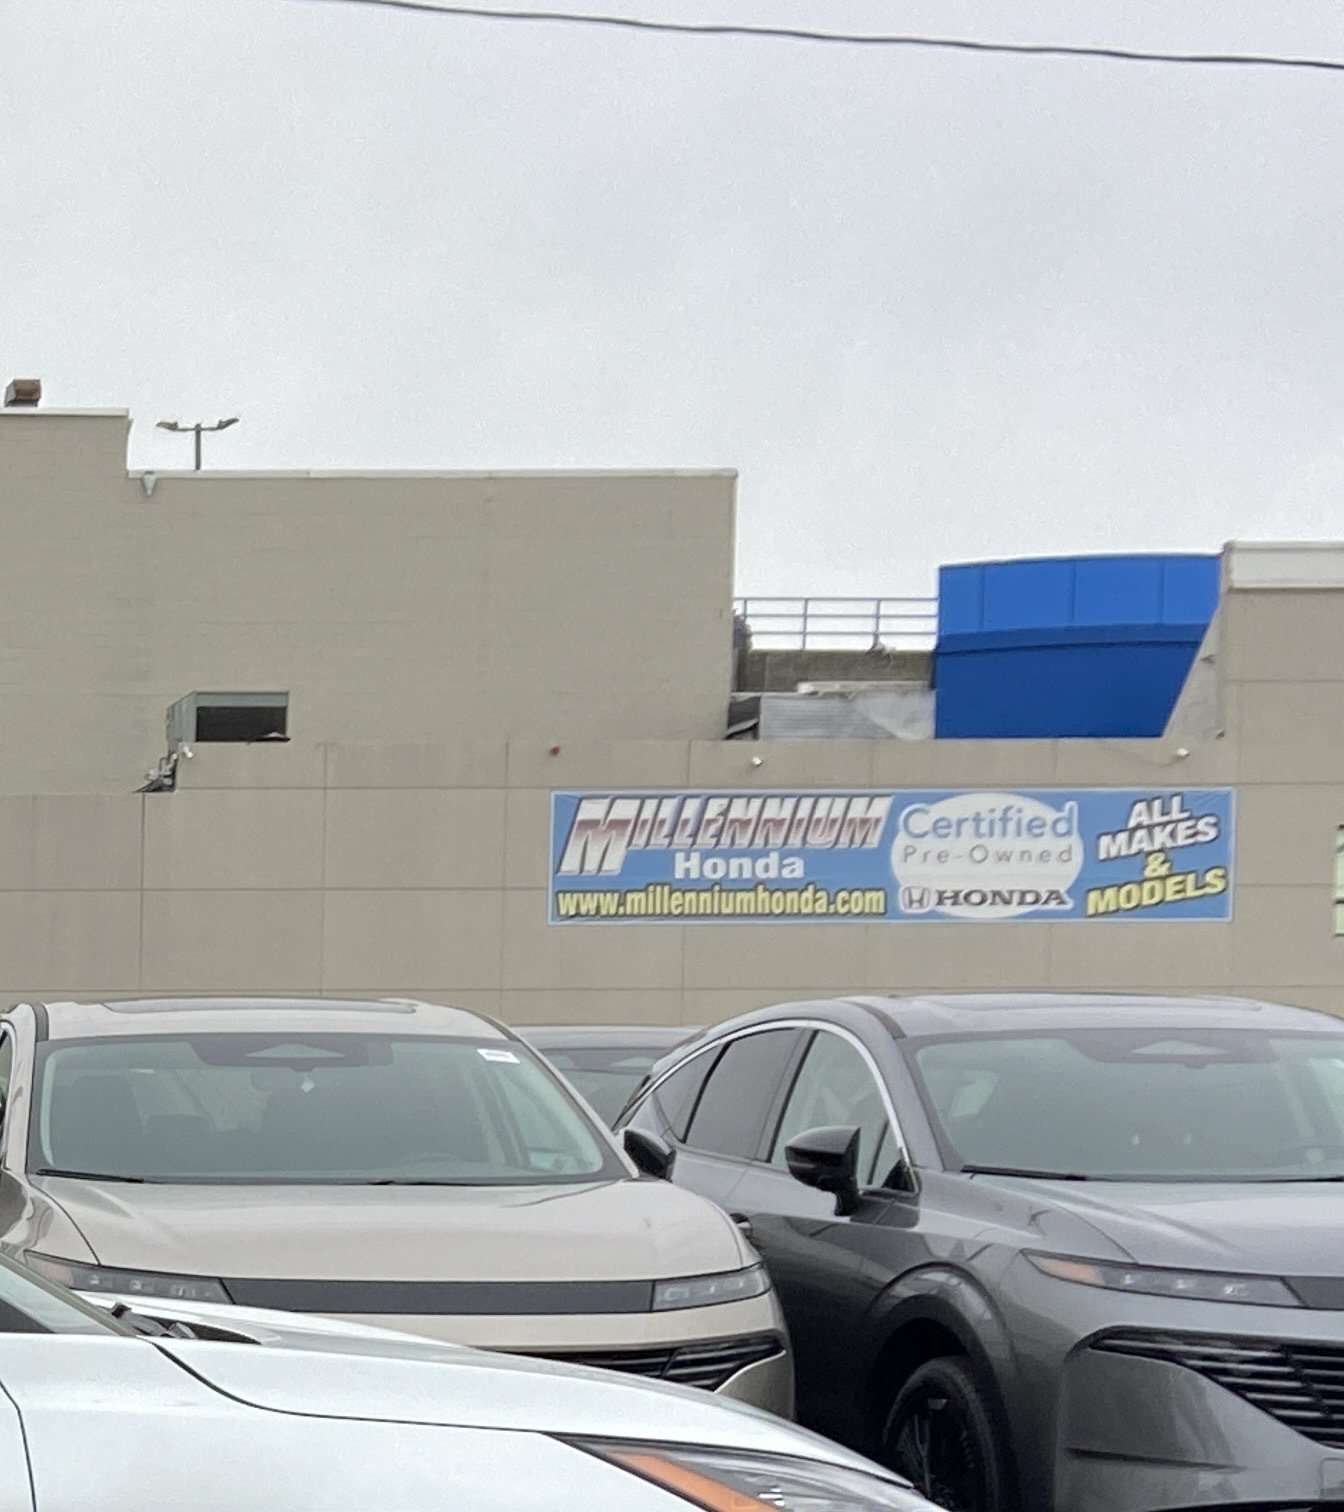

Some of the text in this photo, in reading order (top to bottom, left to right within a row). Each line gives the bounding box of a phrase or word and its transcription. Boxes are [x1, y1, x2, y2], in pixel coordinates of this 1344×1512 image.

[901, 801, 1078, 840] Certified
[1127, 794, 1193, 829] ALL
[902, 844, 1073, 865] Pre-Owned
[1097, 816, 1220, 861] MAKES
[673, 851, 806, 880] Honda
[1143, 851, 1172, 879] &
[556, 884, 887, 917] www.millenniumhonda.com
[935, 889, 1069, 908] HONDA
[1086, 866, 1228, 918] MODELS
